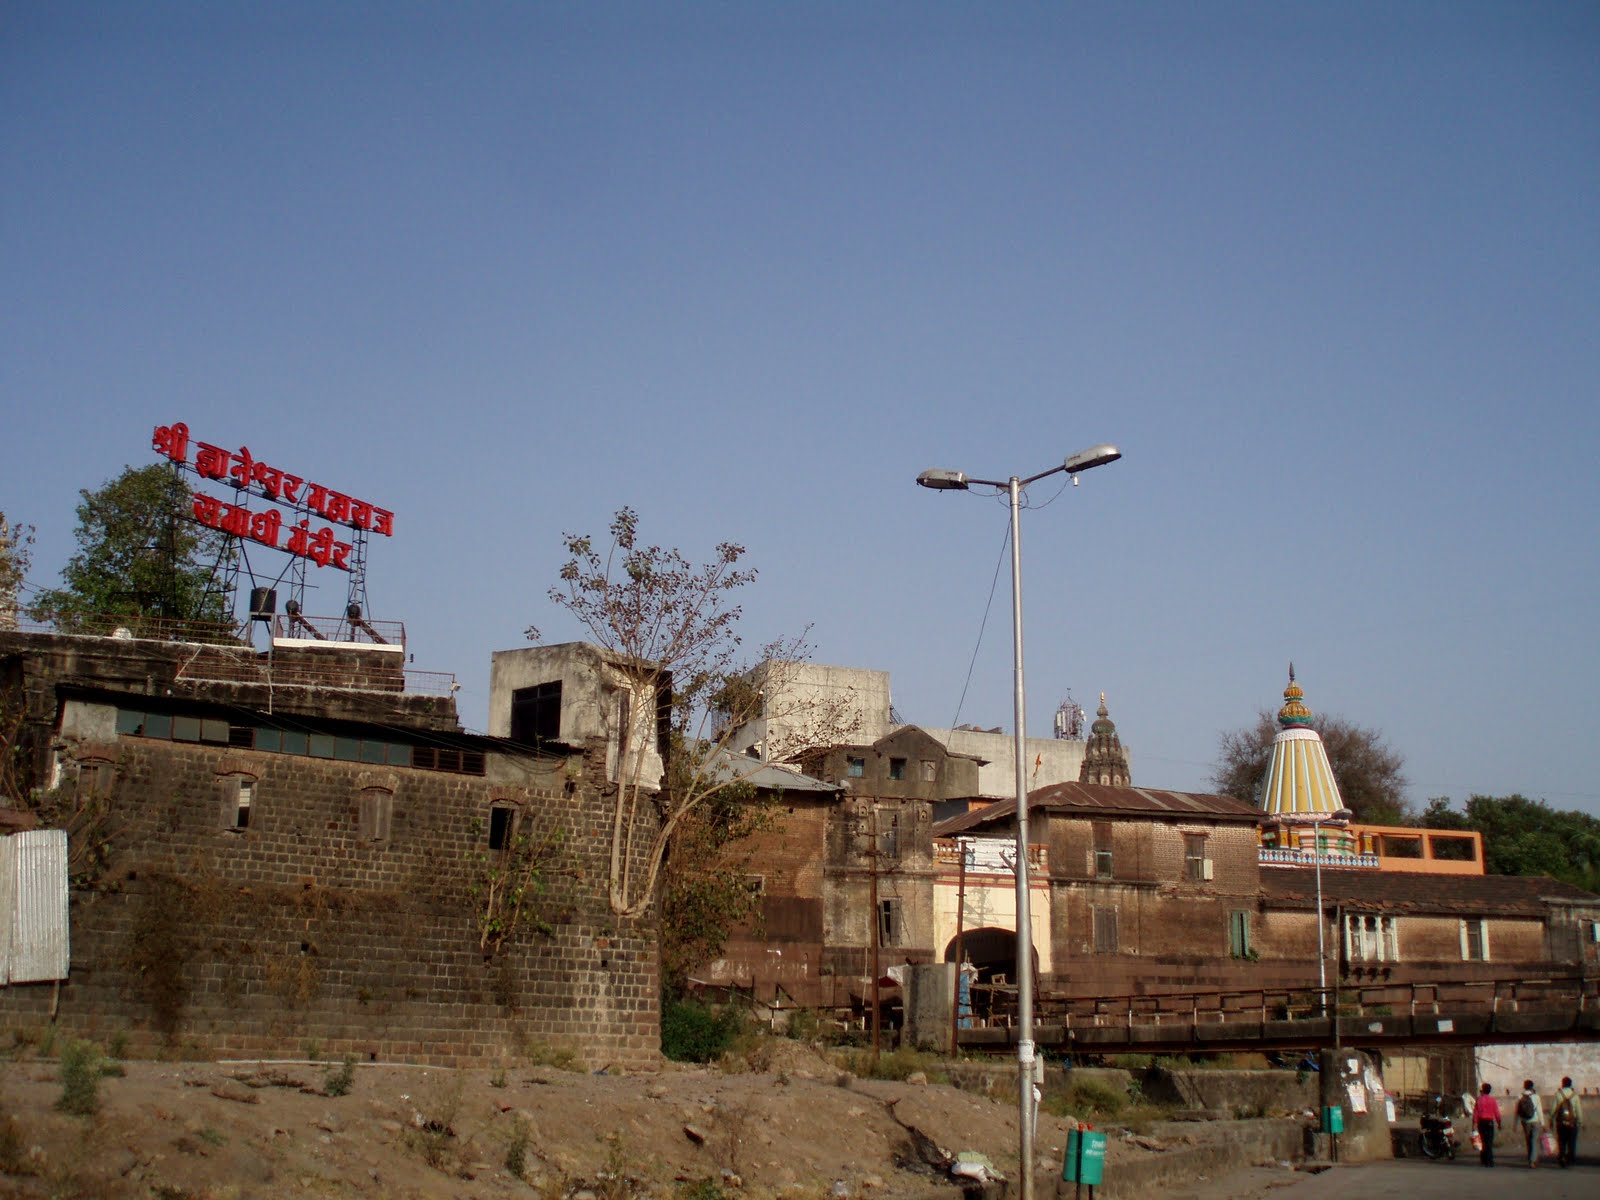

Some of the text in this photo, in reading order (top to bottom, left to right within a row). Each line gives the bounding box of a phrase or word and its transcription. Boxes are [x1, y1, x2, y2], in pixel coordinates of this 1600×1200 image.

[152, 422, 395, 537] श्री ज्ञानेश्वर महाराज
[191, 492, 283, 548] समाधी
